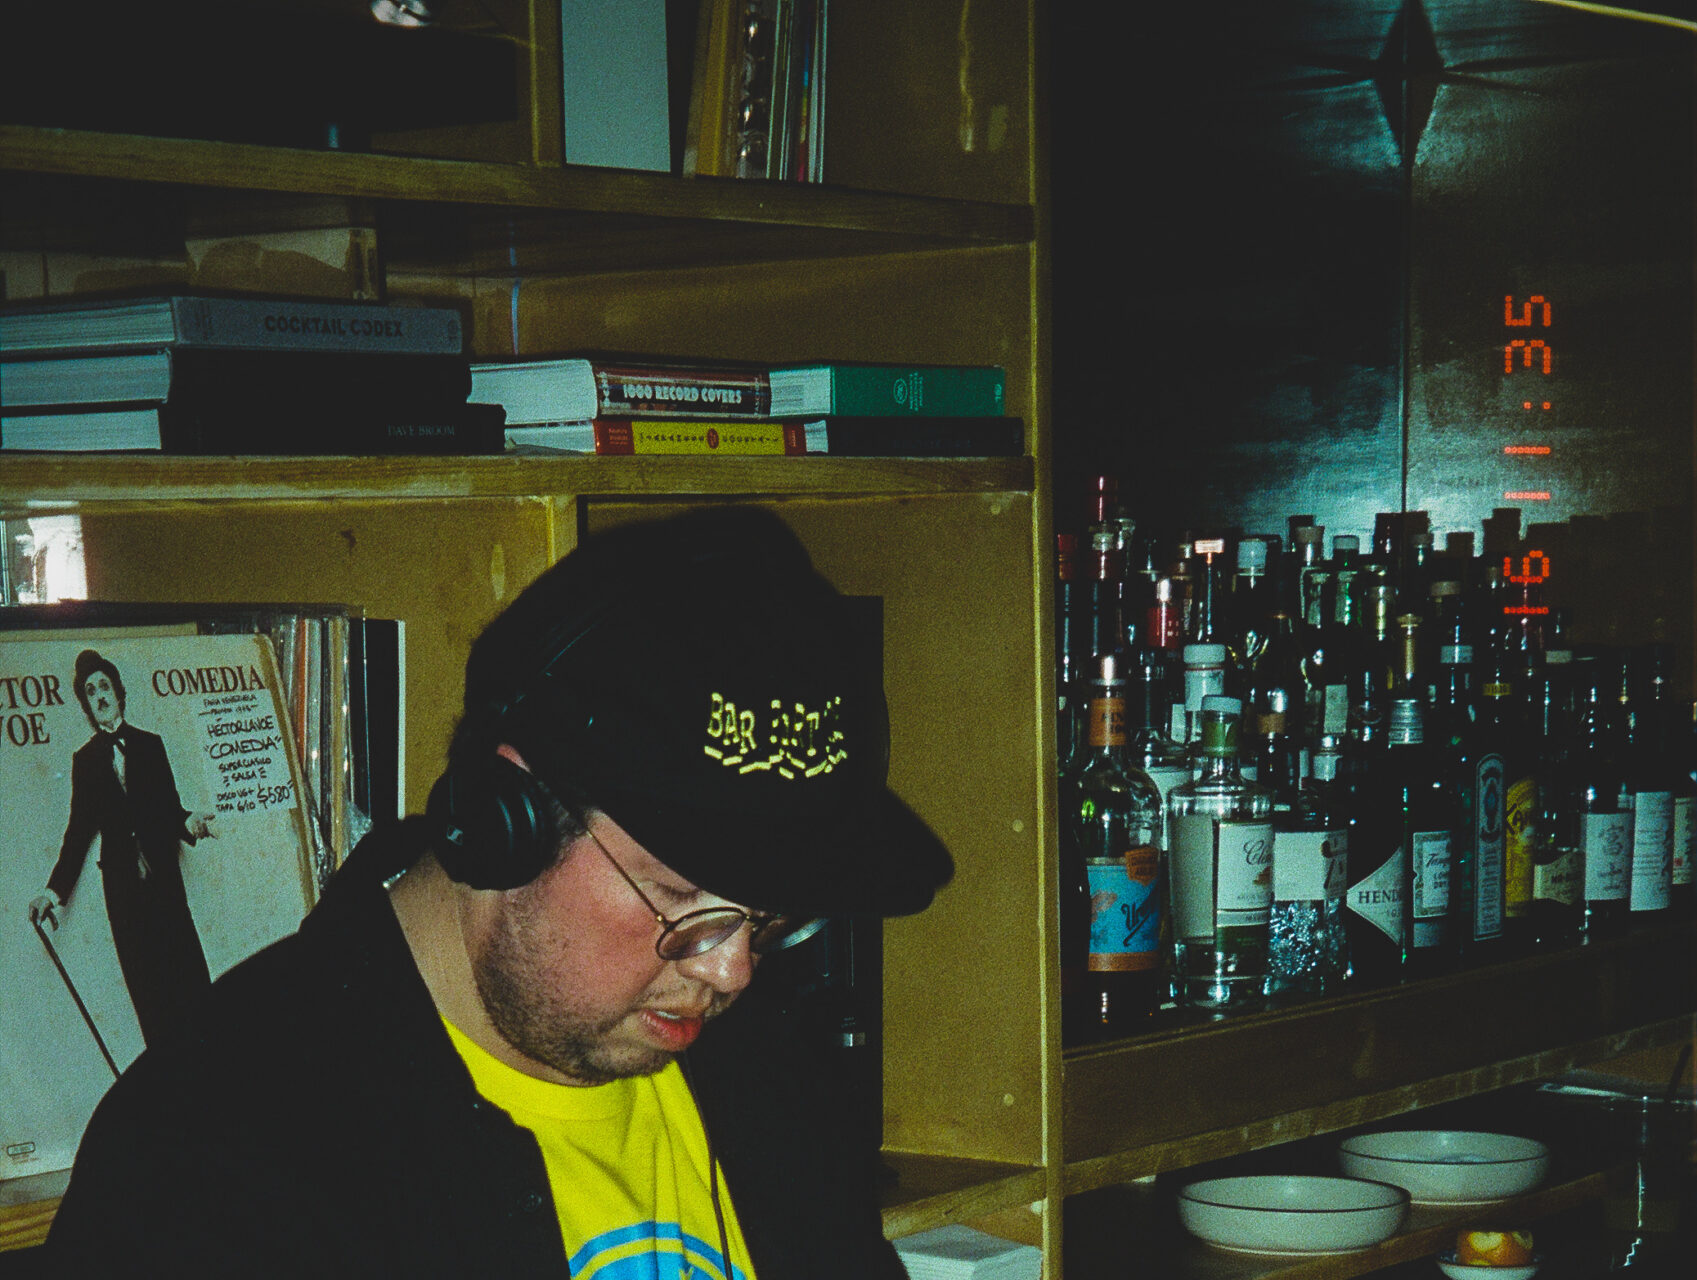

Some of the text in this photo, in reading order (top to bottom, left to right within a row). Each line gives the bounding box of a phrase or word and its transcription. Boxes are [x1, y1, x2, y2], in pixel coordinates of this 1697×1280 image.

[264, 315, 403, 338] COCKTAIL CODEX
[623, 384, 653, 399] 1000
[655, 385, 699, 402] RECORD
[701, 387, 742, 404] COVERS
[387, 425, 455, 437] DAVE BROOM
[0, 665, 267, 710] TOR COMEDIA
[0, 712, 50, 747] OE
[706, 692, 758, 755] BAR
